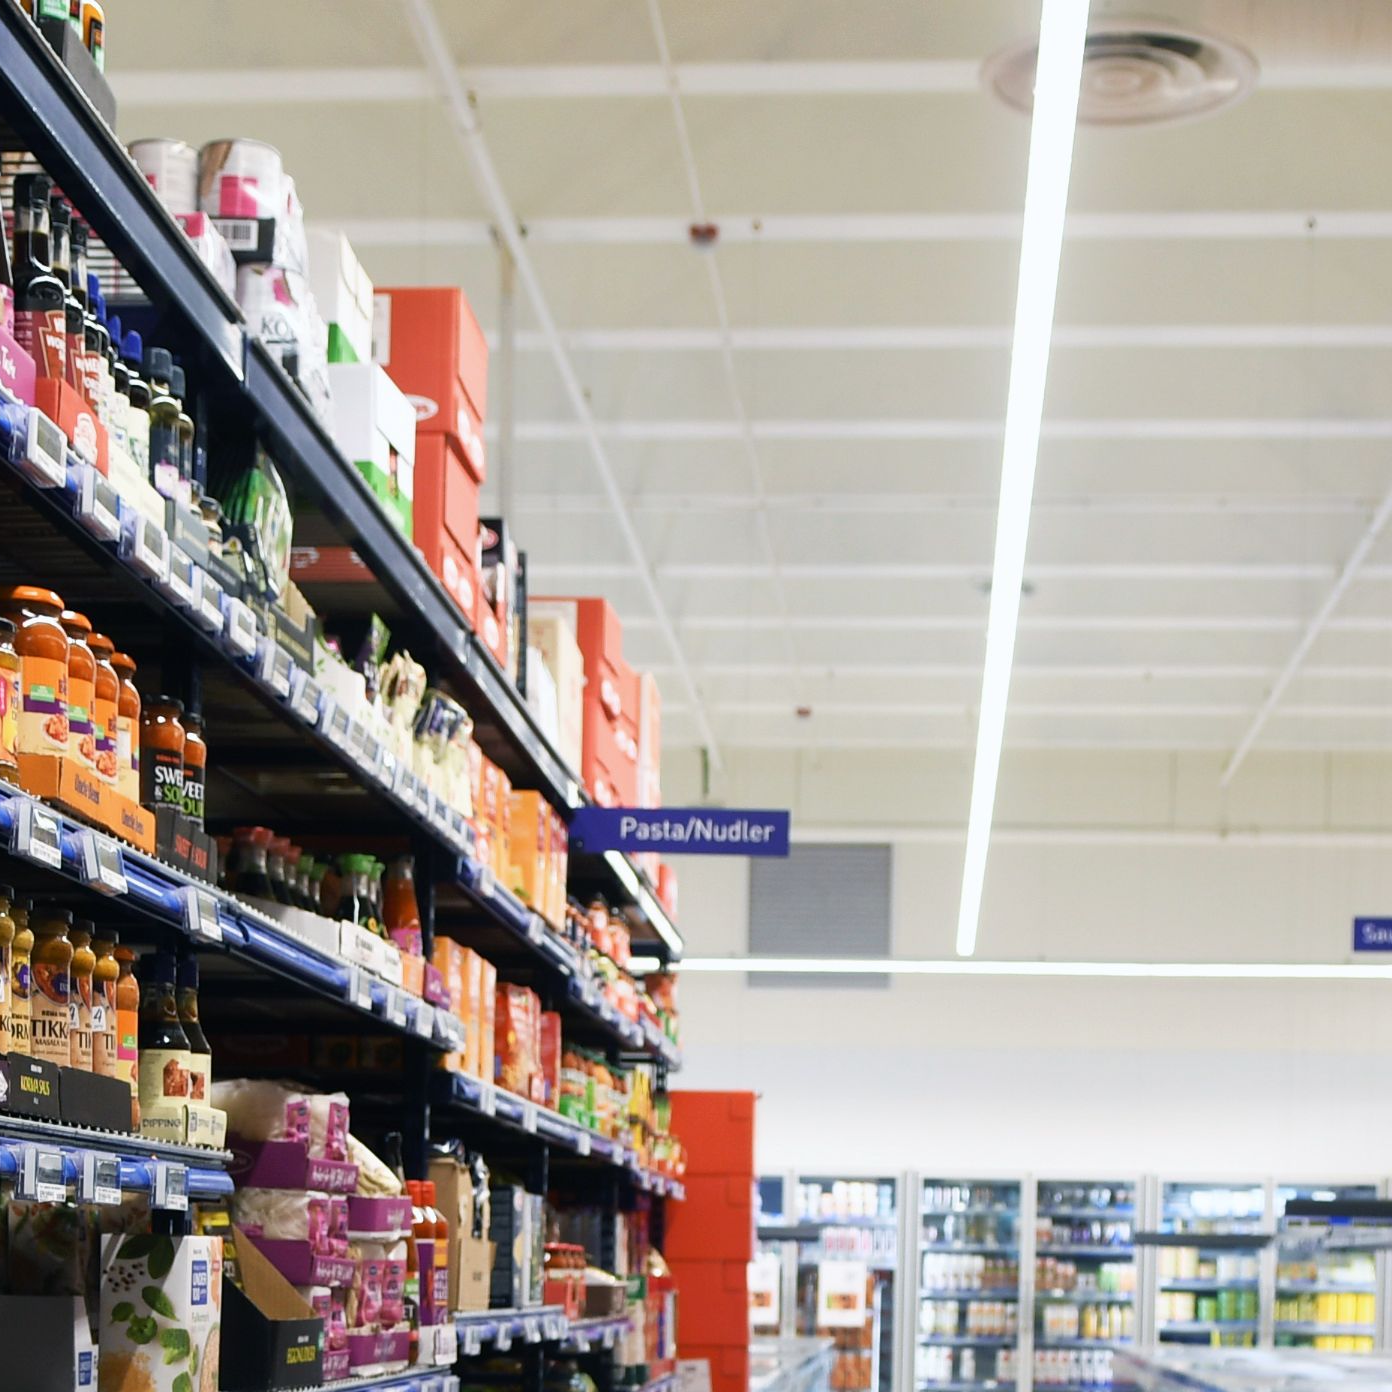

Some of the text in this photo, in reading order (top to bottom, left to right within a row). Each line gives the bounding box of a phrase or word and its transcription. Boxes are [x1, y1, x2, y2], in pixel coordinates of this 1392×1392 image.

[619, 816, 776, 843] Pasta/Nudler
[30, 1018, 68, 1041] TIKK
[141, 1117, 182, 1129] DIPPING
